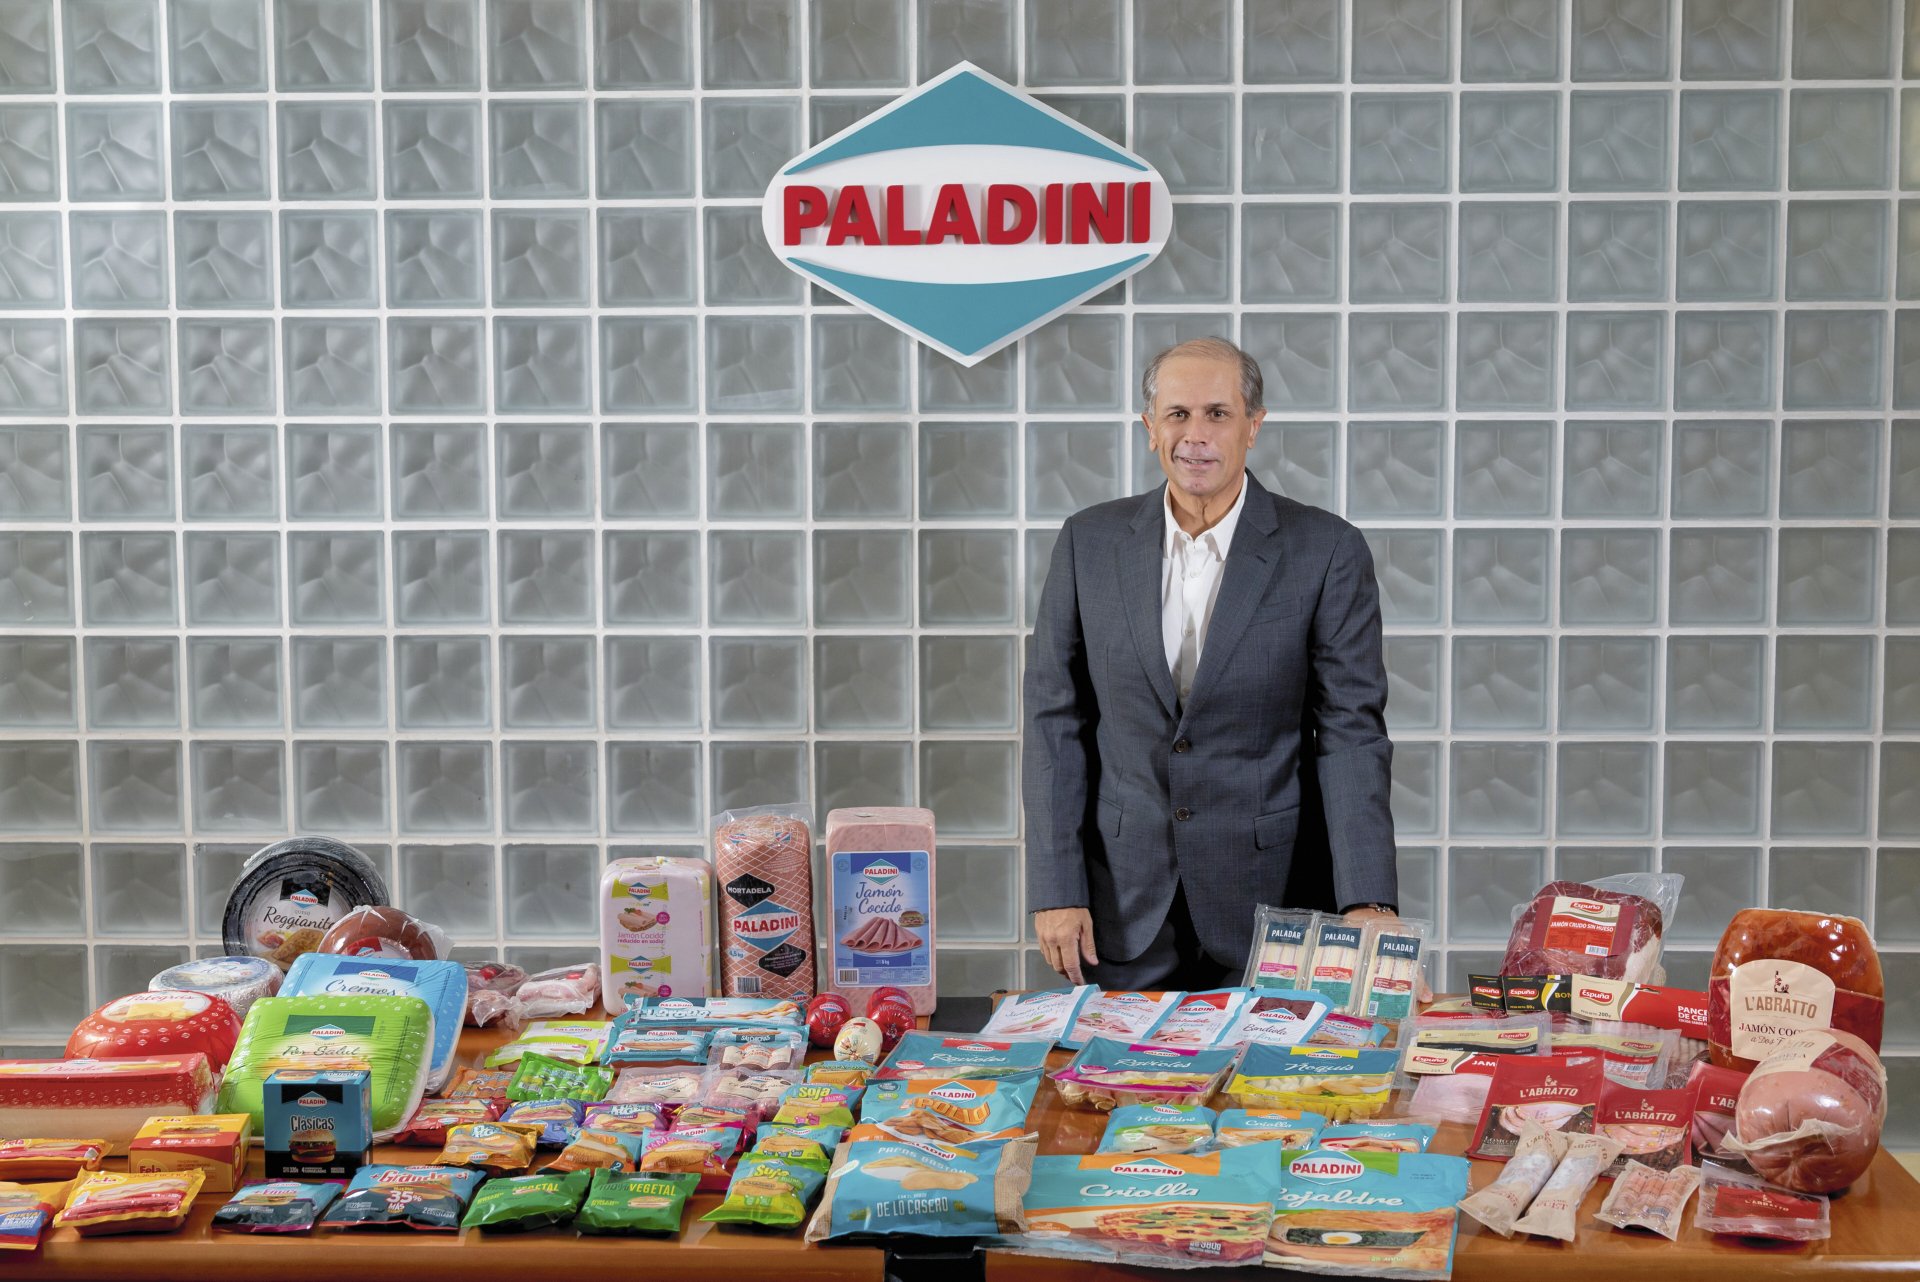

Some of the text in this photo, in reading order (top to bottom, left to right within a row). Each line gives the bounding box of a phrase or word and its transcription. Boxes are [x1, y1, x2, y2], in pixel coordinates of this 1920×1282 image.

[783, 181, 1151, 246] PALADINI
[727, 886, 773, 895] MORTADELA
[855, 881, 904, 899] Jamón
[291, 895, 318, 904] PALADINI
[858, 898, 903, 914] Cocido
[1573, 902, 1601, 910] Espuña
[733, 915, 799, 933] PALADINI
[1271, 929, 1301, 939] PALADAR
[1324, 933, 1355, 943] PALADAR
[1383, 942, 1414, 953] PALADAR
[325, 979, 409, 996] Cremos
[1475, 986, 1500, 995] Espuña
[1510, 988, 1536, 996] Espuña
[1581, 990, 1610, 1000] Espuña
[1745, 995, 1817, 1019] L'ABRATTO
[1259, 1012, 1296, 1021] PALADINI
[1739, 1023, 1803, 1037] JAMÓN COC
[1415, 1056, 1445, 1064] Espuña
[798, 1086, 832, 1100] Soja
[930, 1090, 975, 1099] PALADINI
[1520, 1087, 1579, 1098] L'ABRATTO
[1615, 1110, 1677, 1122] L'ABRATTO
[290, 1115, 335, 1132] Clásicas
[753, 1164, 790, 1179] Soja
[1114, 1166, 1183, 1176] PALADINI
[1292, 1163, 1362, 1175] PALADINI
[629, 1183, 677, 1196] VEGETAL
[1079, 1182, 1201, 1198] Criolla
[386, 1190, 422, 1203] 35%
[1279, 1189, 1405, 1208] ojaldre
[876, 1196, 949, 1218] DE LO CASERO
